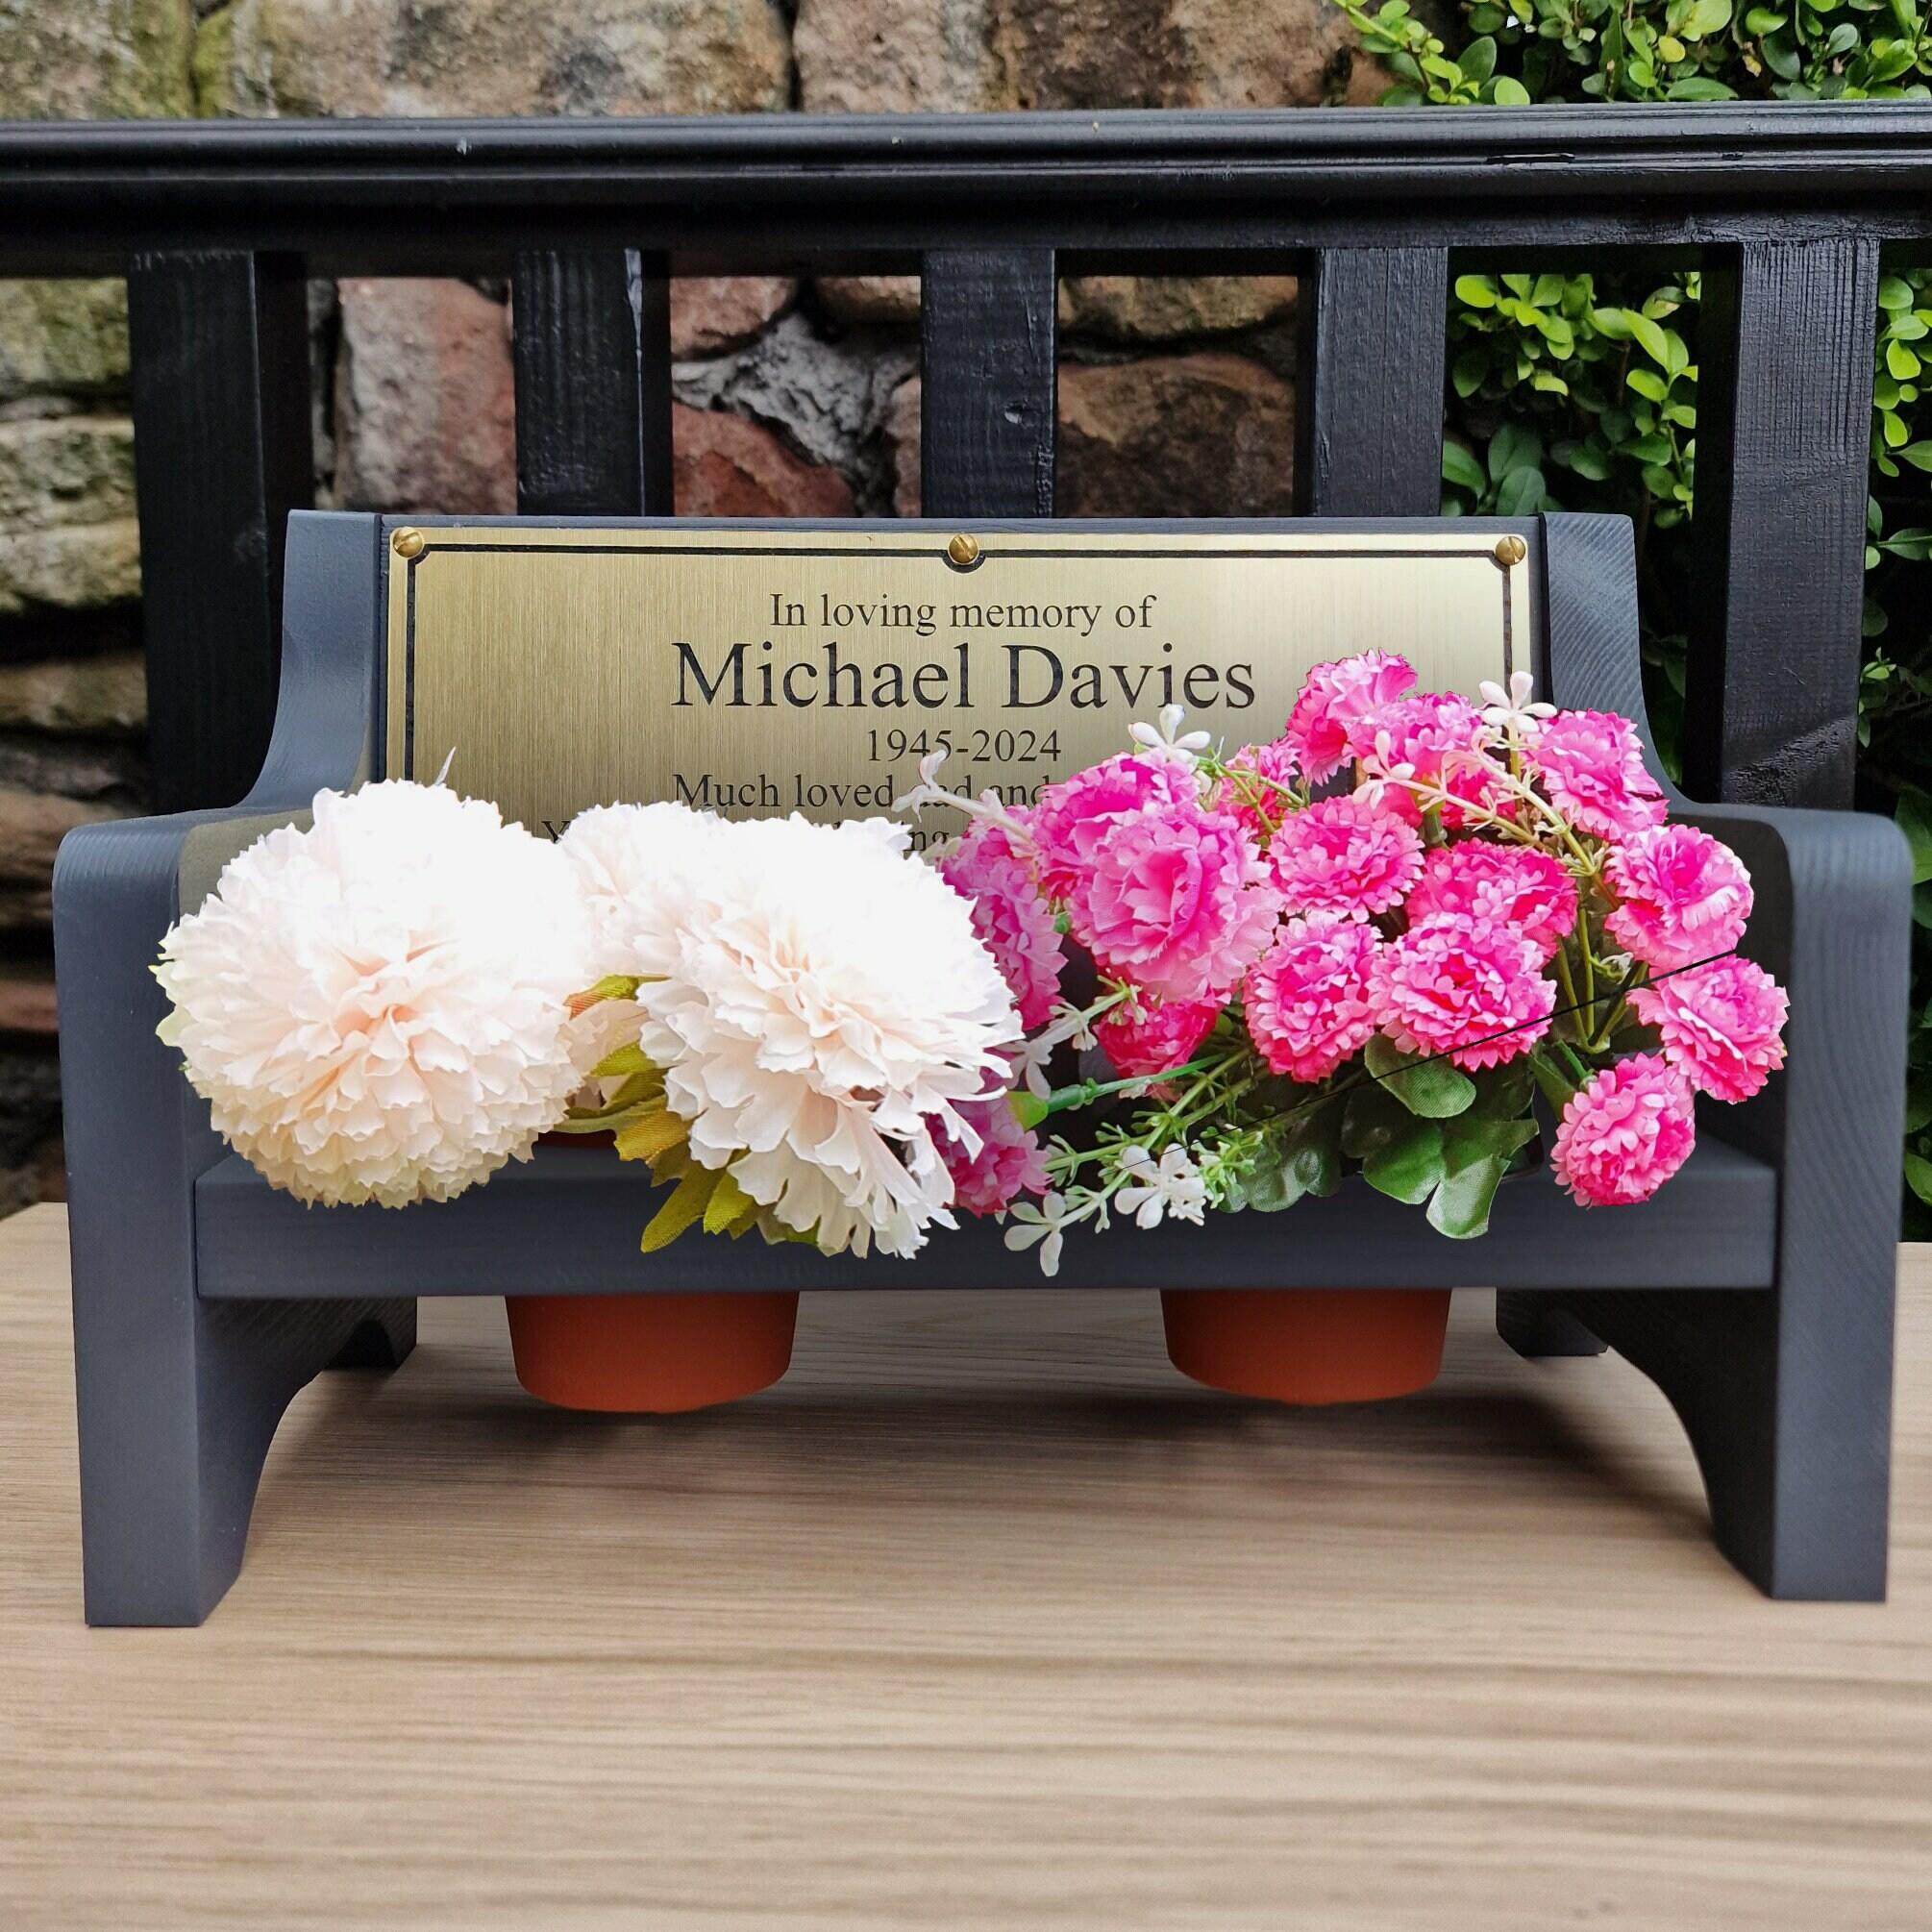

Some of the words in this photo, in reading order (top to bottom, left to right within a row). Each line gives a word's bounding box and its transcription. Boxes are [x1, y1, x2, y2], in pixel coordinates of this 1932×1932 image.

[770, 593, 805, 626] In
[821, 593, 936, 636] loving
[951, 605, 1101, 636] memory
[1115, 595, 1157, 628] of
[671, 641, 975, 708] Michael
[1002, 643, 1255, 708] Davies
[868, 729, 1061, 761] 1945-2024
[672, 774, 781, 807] Much
[795, 774, 894, 807] loved
